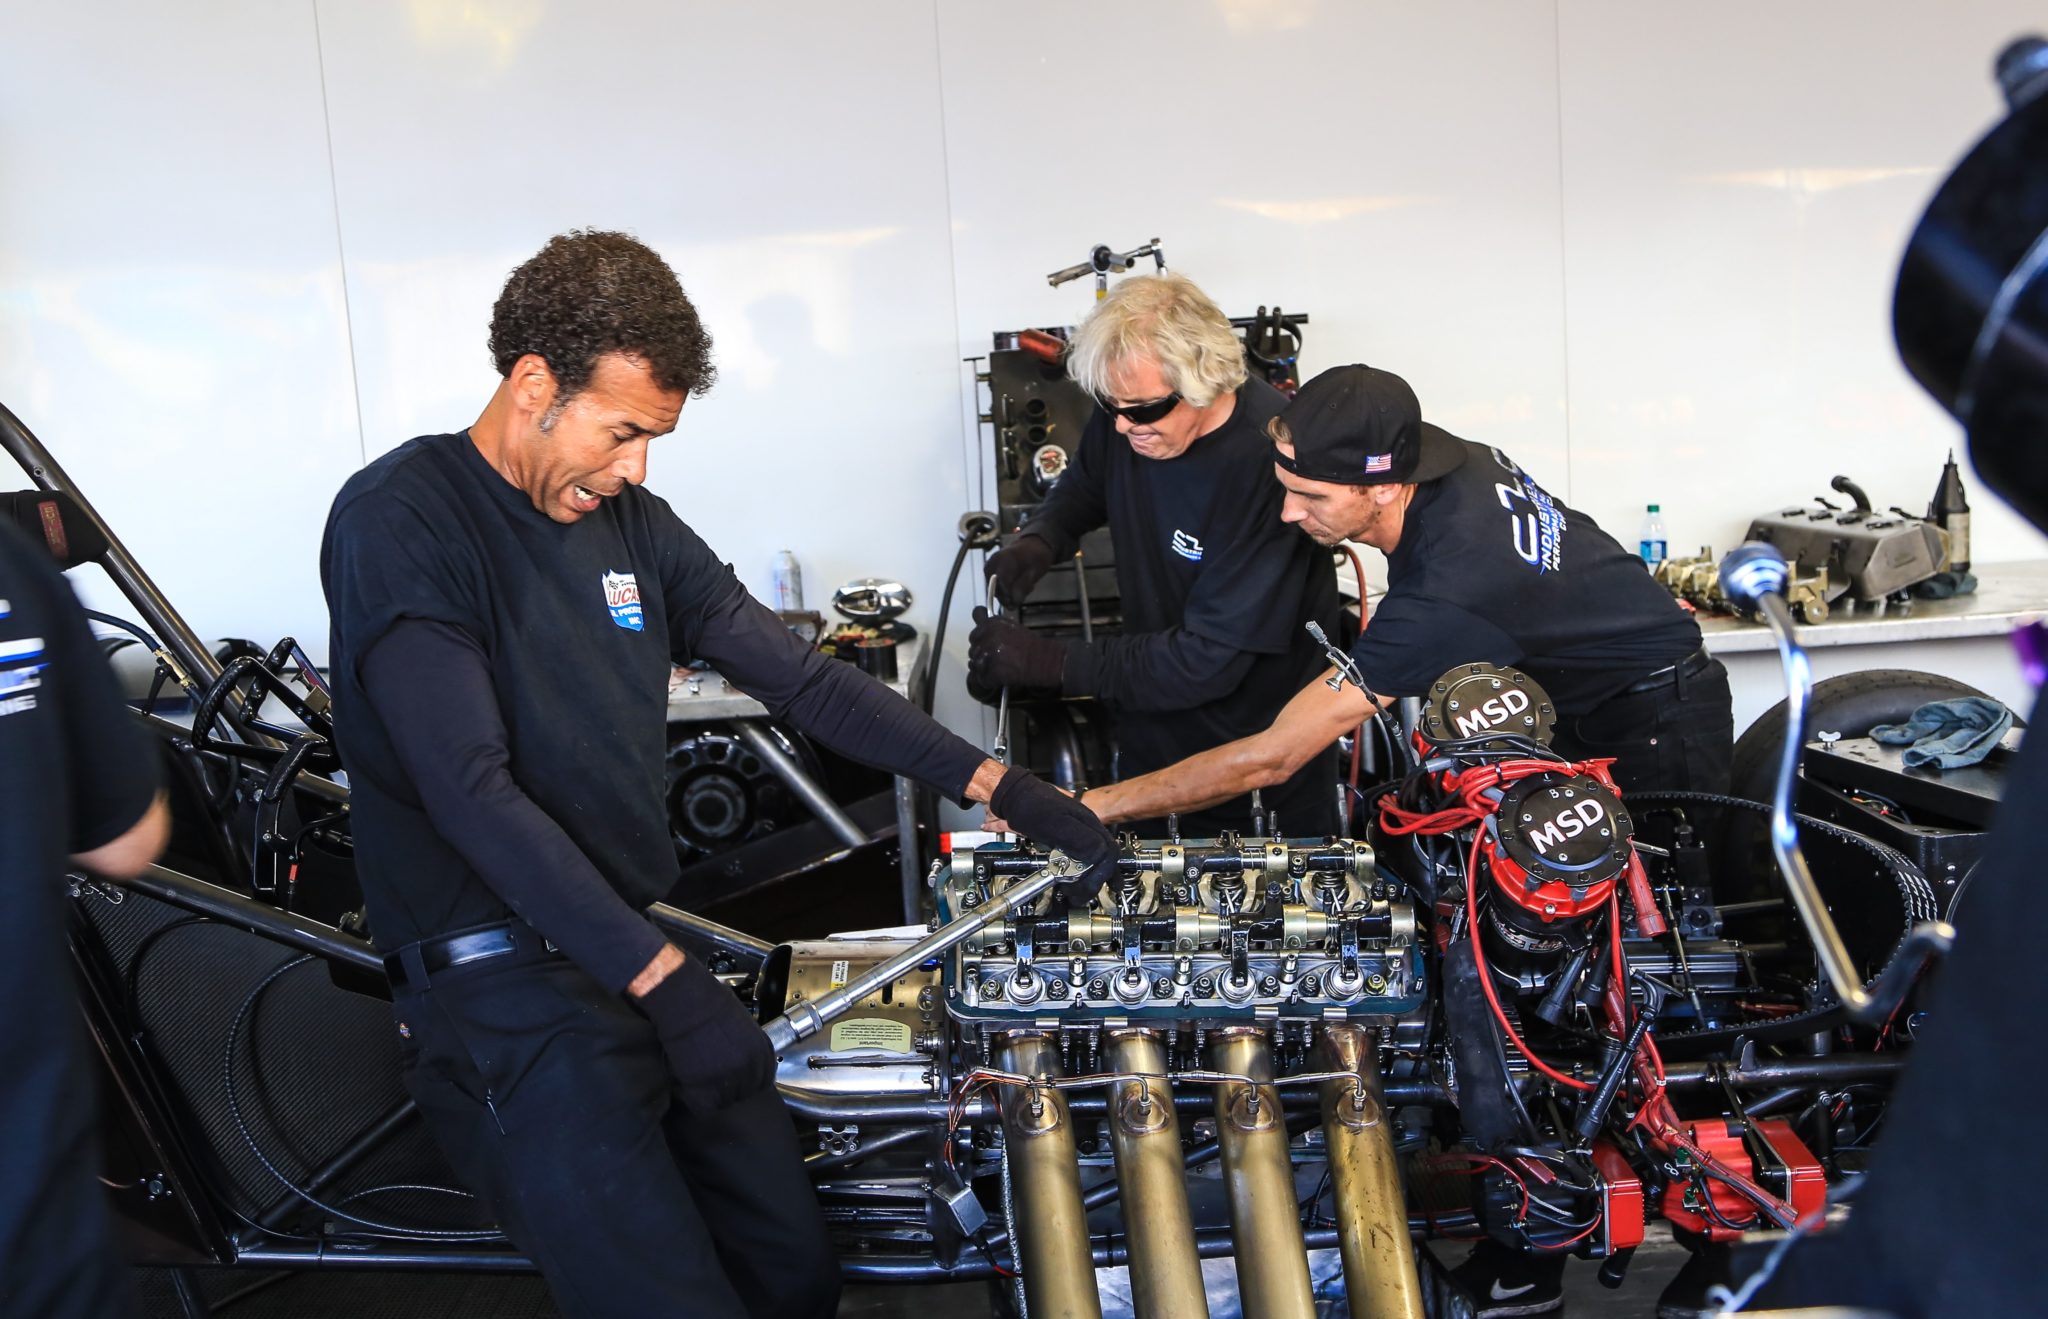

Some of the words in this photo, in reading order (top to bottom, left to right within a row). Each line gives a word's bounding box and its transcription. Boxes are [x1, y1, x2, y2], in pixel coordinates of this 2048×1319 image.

[1456, 690, 1529, 738] MSD
[1549, 788, 1559, 799] B
[1530, 799, 1604, 854] MSD
